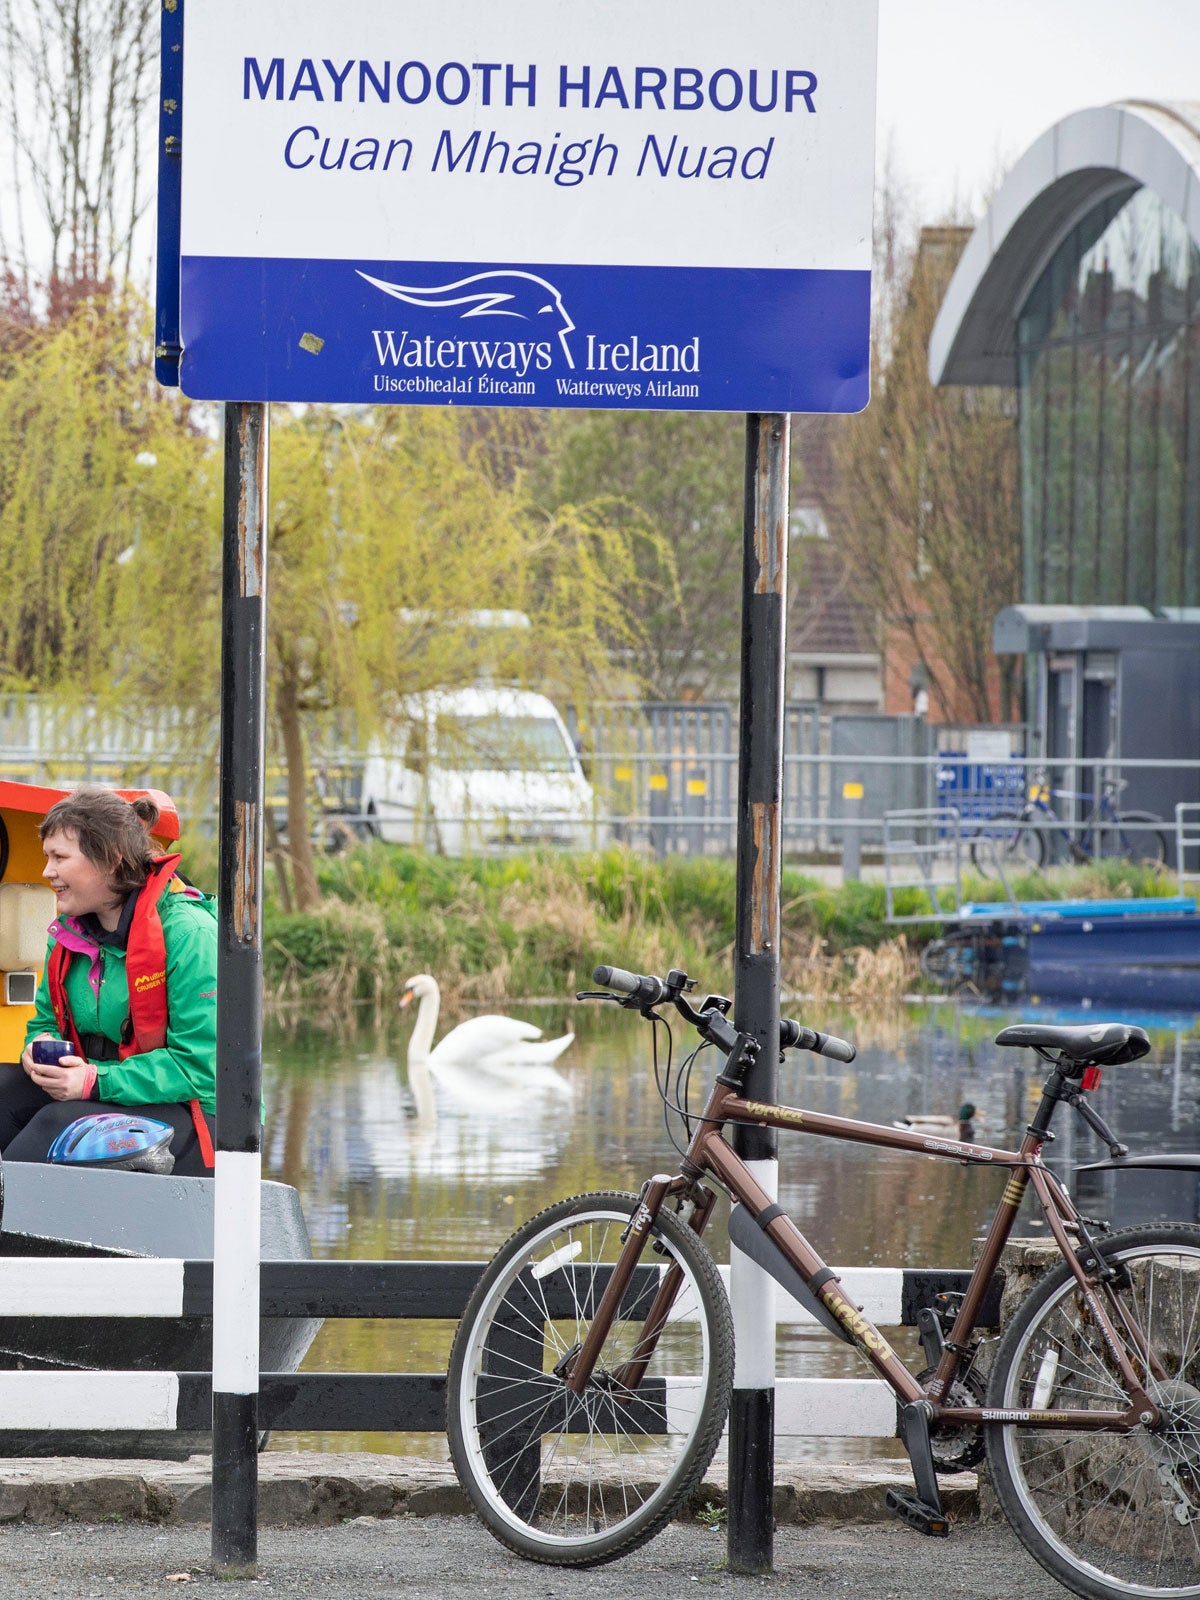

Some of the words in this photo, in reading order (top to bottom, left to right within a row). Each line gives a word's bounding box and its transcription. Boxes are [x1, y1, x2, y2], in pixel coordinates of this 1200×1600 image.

[243, 56, 537, 107] MAYNOOTH
[559, 64, 818, 114] HARBOUR
[284, 125, 413, 172] Cuan
[431, 129, 619, 187] Mhaigh
[636, 134, 775, 180] Nuad
[371, 330, 552, 378] Waterways
[586, 334, 700, 373] Ireland
[374, 375, 473, 394] Uiscebhealaí
[478, 373, 536, 395] Éireann
[556, 378, 642, 400] Watterweys
[646, 380, 699, 397] Airlann
[982, 1410, 1030, 1421] SHIMANO
